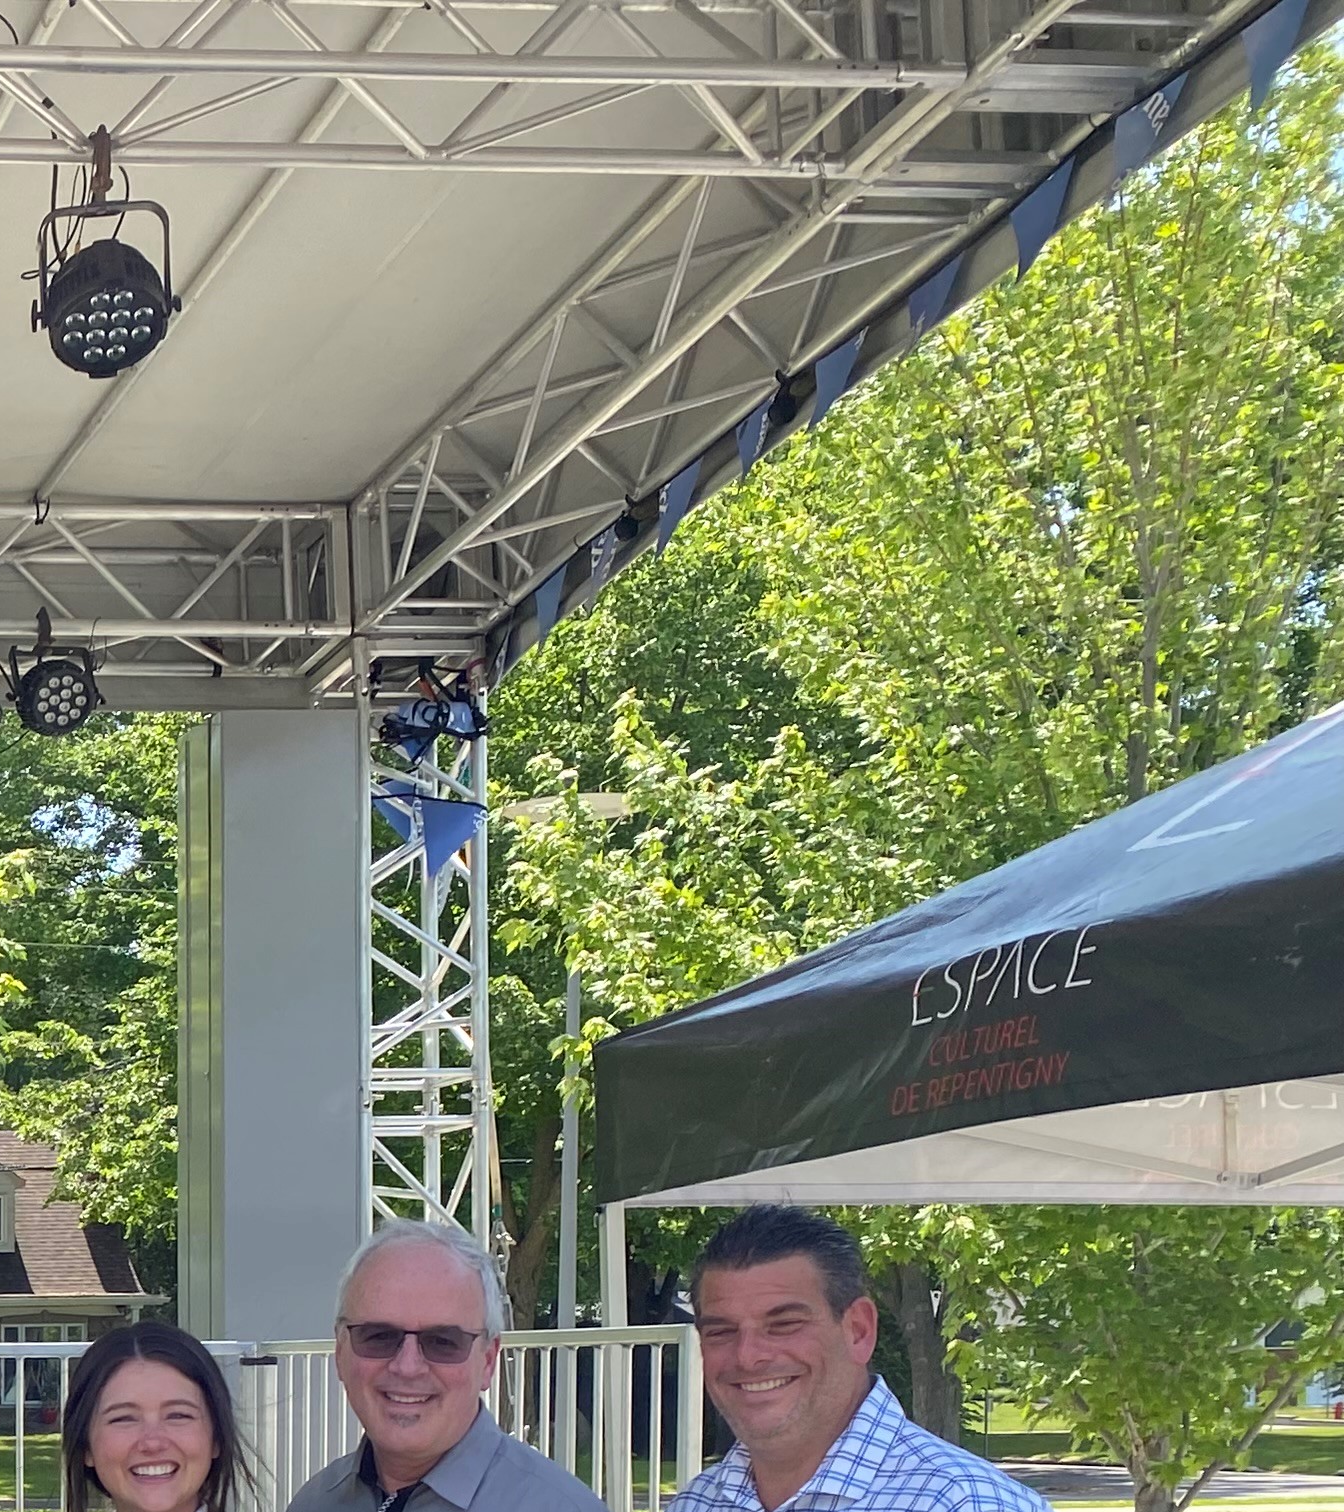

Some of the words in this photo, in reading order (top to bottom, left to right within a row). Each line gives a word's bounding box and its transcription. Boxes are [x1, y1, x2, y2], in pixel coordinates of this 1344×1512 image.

[912, 919, 1114, 1026] ESPACE
[928, 1015, 1039, 1066] CULTUREL
[892, 1082, 922, 1115] DE
[925, 1052, 1070, 1110] REPENTIGNY
